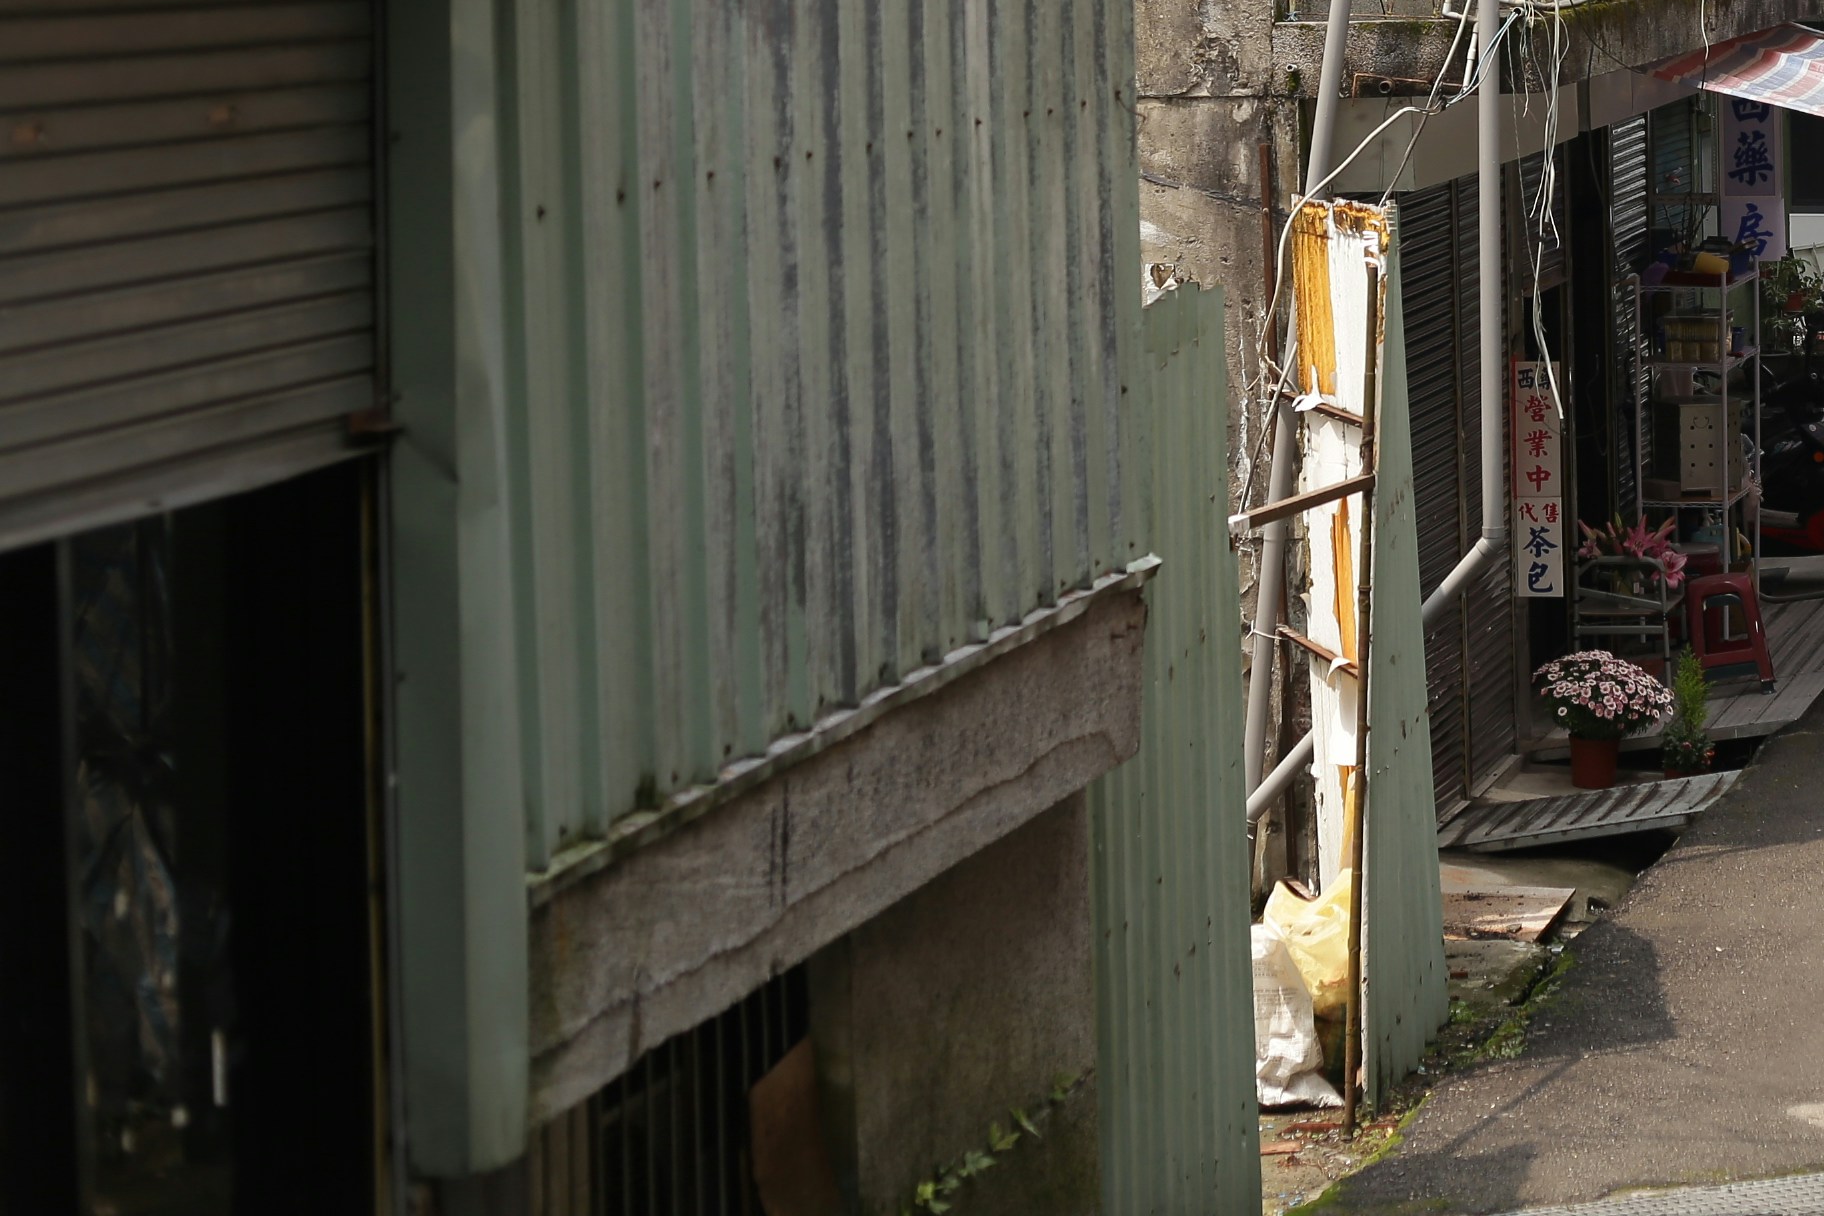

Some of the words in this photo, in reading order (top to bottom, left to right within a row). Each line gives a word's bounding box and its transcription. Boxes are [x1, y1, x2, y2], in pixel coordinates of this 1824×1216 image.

[1524, 395, 1553, 493] 營業中
[1518, 502, 1560, 523] 代售
[1523, 526, 1558, 593] 茶包
